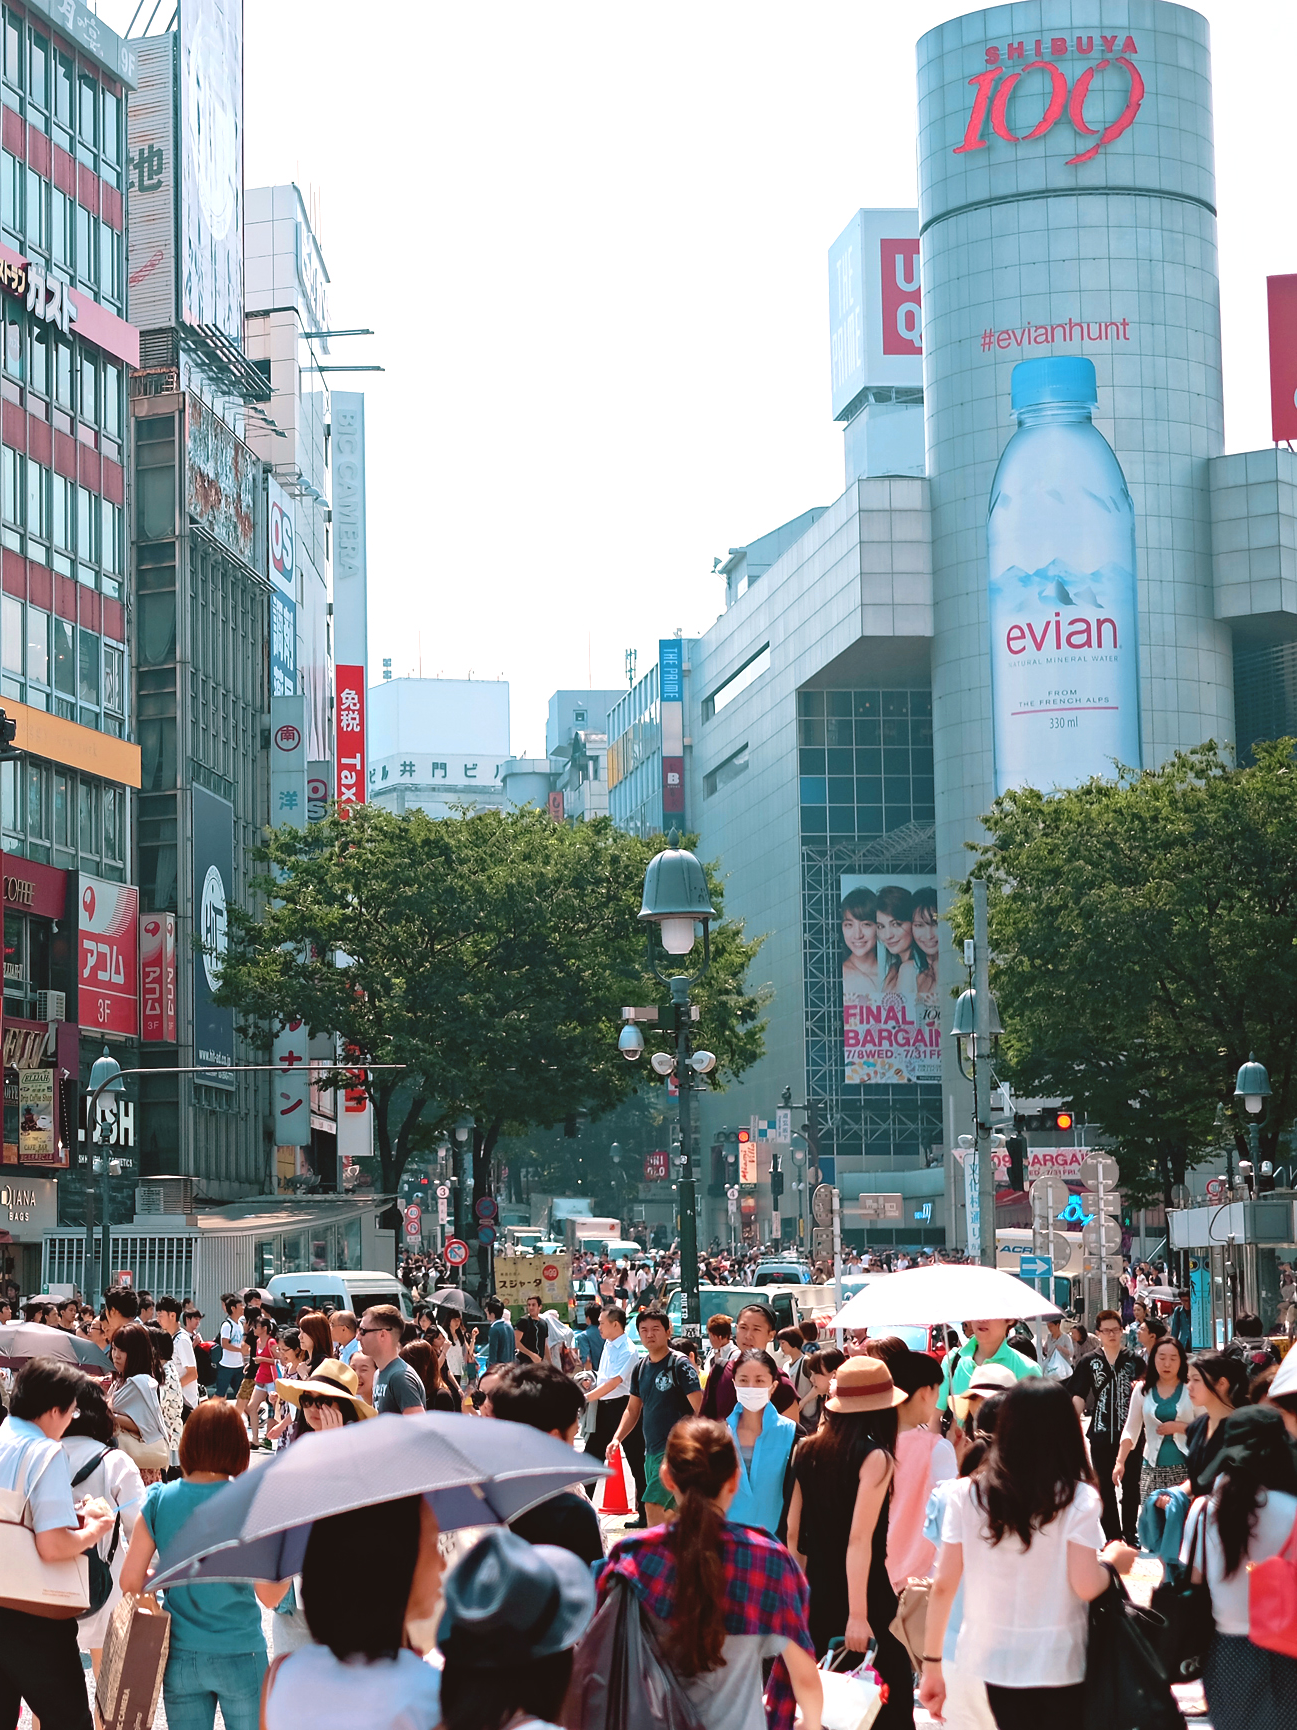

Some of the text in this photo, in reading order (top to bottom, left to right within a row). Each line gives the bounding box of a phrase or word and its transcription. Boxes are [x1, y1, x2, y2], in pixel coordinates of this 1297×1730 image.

[120, 46, 136, 78] 9F
[984, 35, 1139, 66] SHIBUYA
[952, 56, 1145, 166] 109
[27, 263, 79, 338] ガスト
[980, 318, 1131, 353] #evianhunt
[337, 408, 360, 580] BIC CAMERA
[271, 501, 294, 580] OS
[1006, 611, 1119, 656] evian
[663, 647, 679, 699] THE PRIME
[1046, 655, 1088, 665] MINERAL
[1091, 655, 1119, 663] WATER
[1039, 697, 1082, 706] FRENCH
[1086, 696, 1110, 704] ALPS
[1048, 689, 1077, 697] FROM
[339, 687, 361, 733] 免税
[1049, 716, 1079, 730] 330 ml
[82, 937, 125, 985] アコム
[145, 965, 161, 1017] アコム
[96, 998, 112, 1023] 3F
[147, 1019, 160, 1031] 3F
[844, 1004, 915, 1026] FINAL
[8, 1211, 31, 1222] BAGS
[498, 1278, 543, 1290] スジャータ
